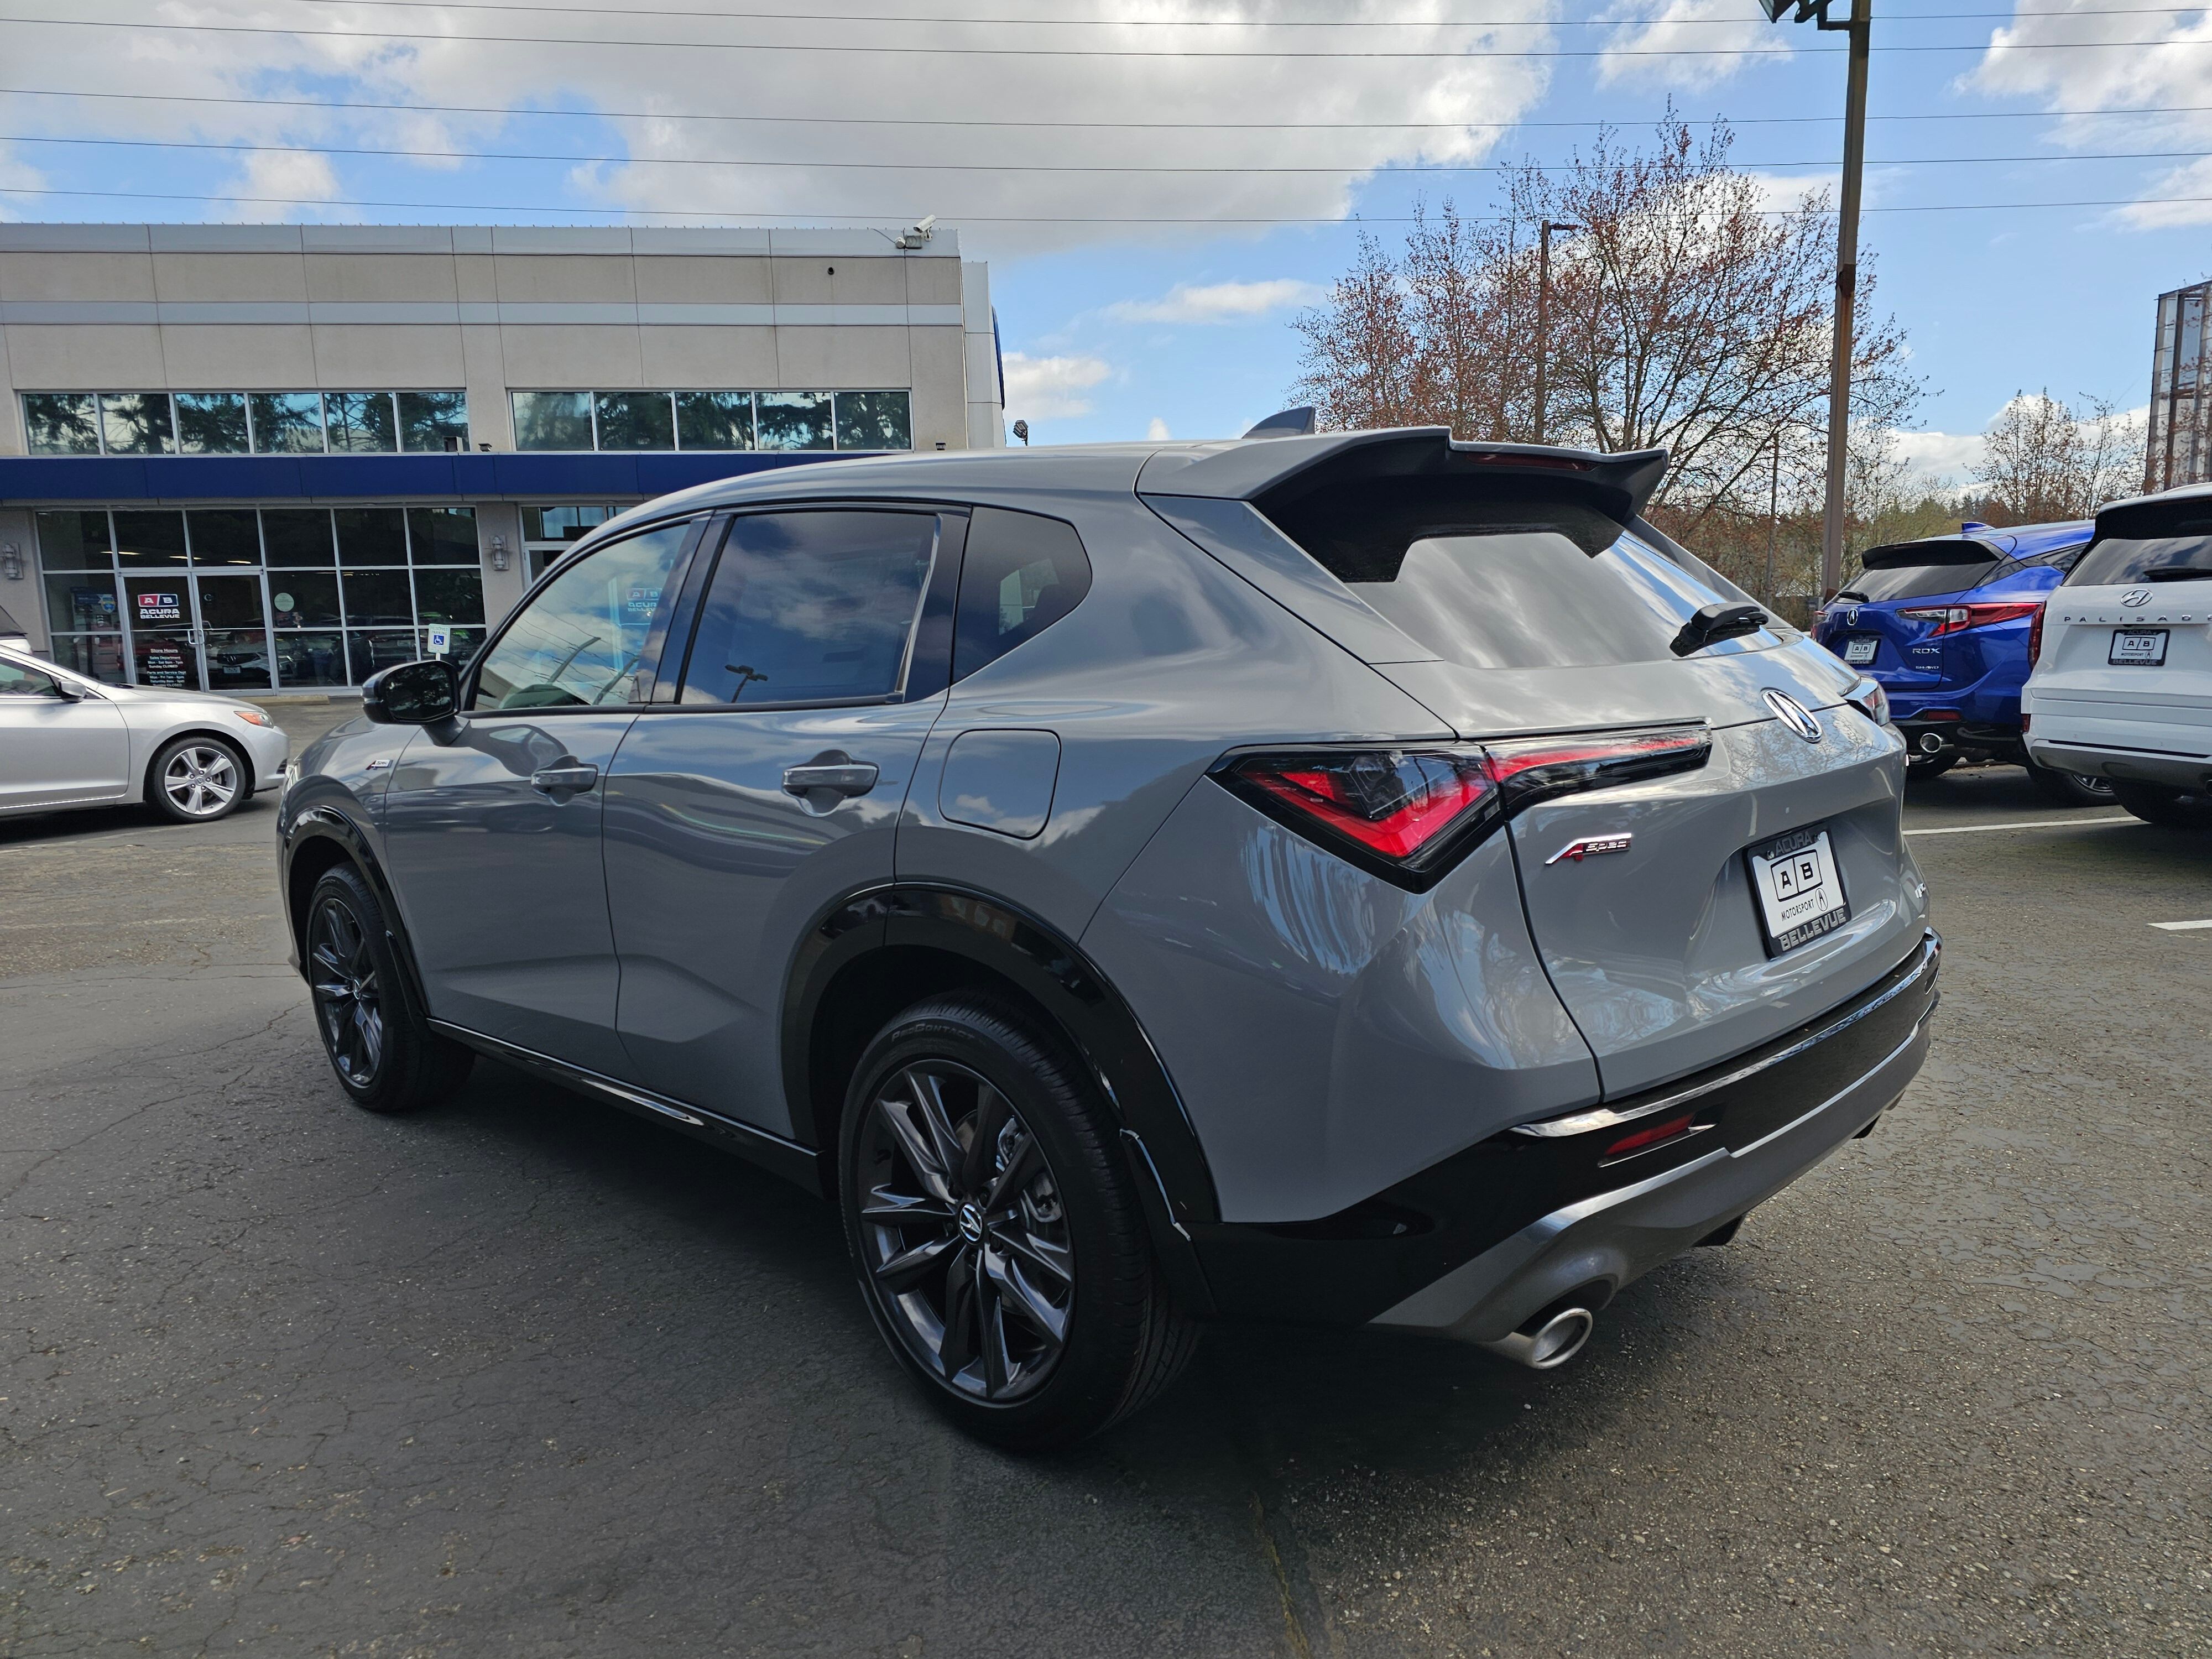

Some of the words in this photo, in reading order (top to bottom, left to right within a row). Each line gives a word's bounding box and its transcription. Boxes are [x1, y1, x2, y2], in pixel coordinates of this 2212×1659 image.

[1775, 831, 1813, 857] ACURA
[1781, 899, 1815, 922] MOTORSPORT
[1778, 907, 1846, 951] BELLEVUE
